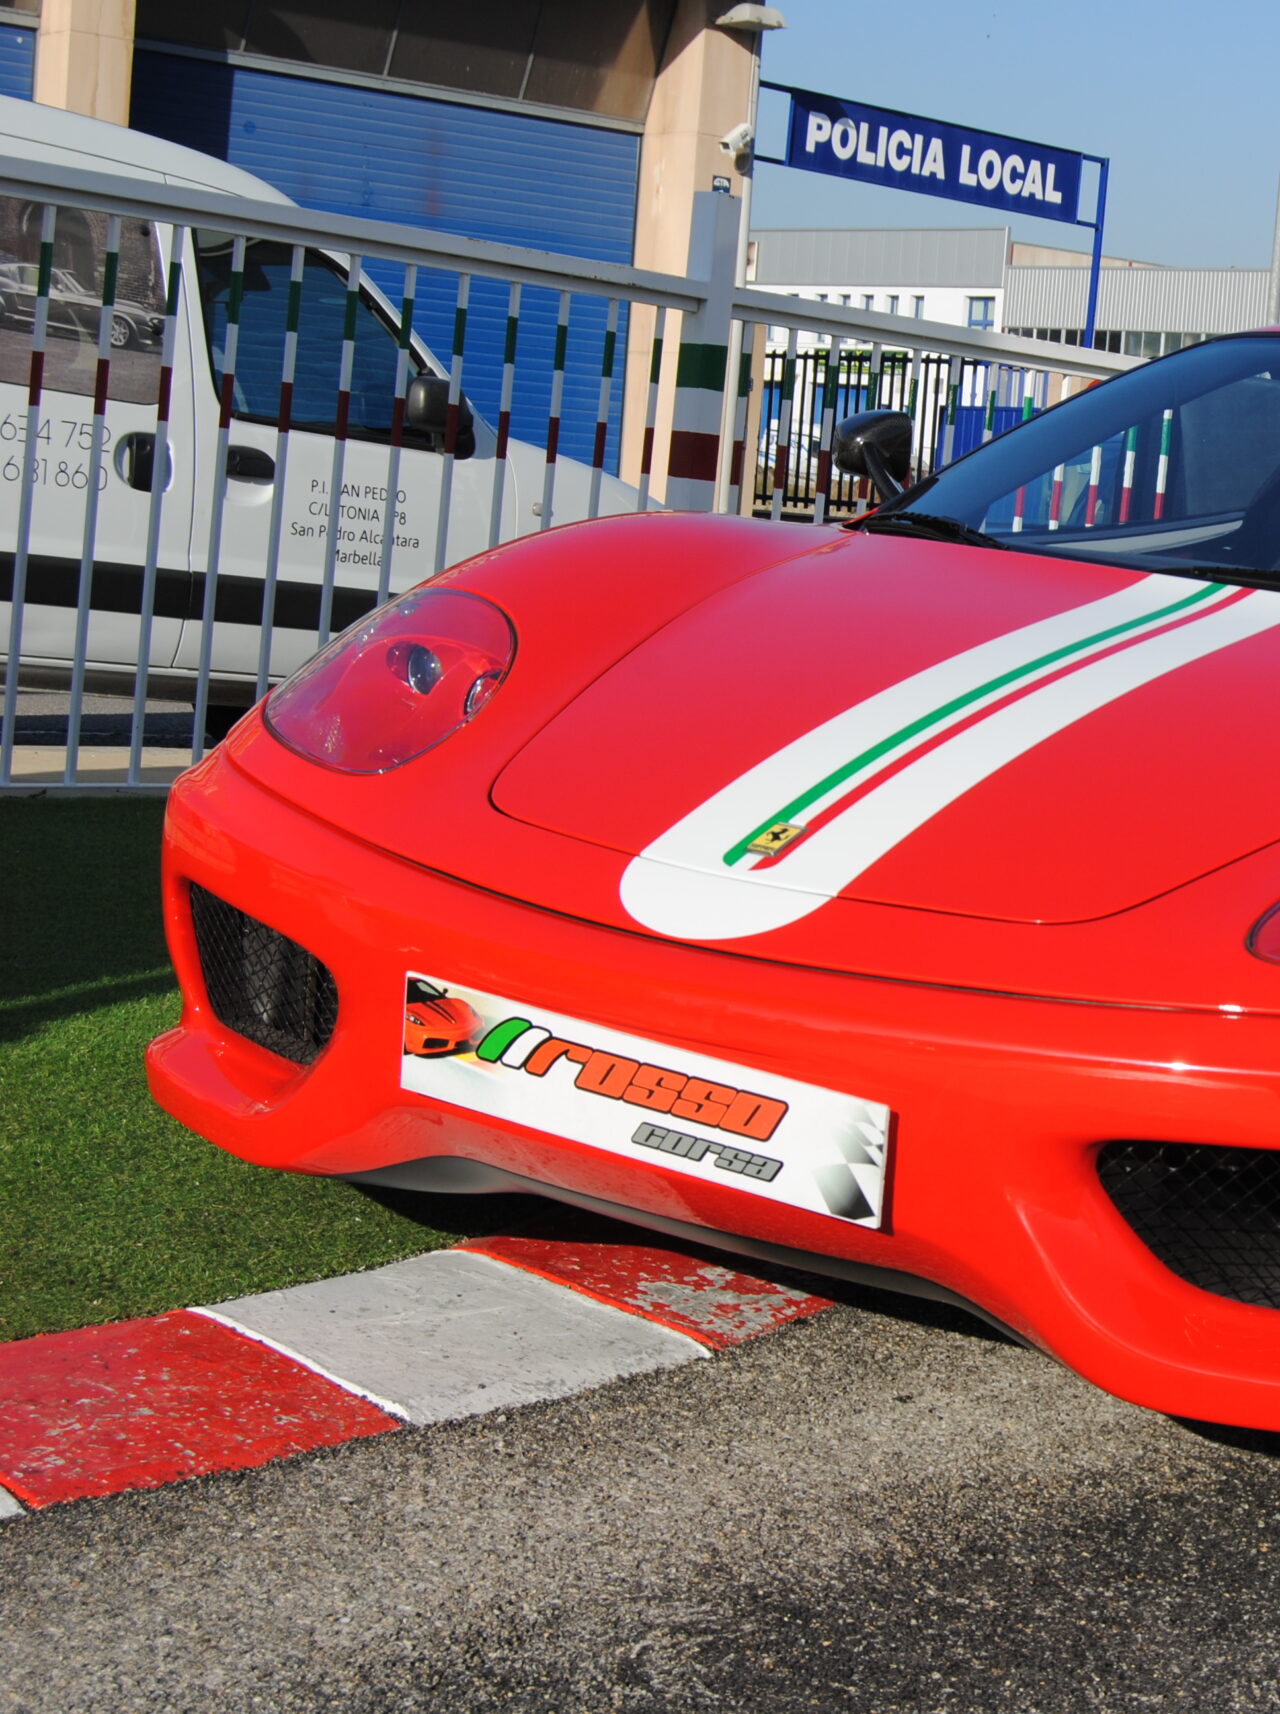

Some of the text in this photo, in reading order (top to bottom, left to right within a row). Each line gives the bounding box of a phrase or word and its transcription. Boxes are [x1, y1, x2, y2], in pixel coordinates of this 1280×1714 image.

[805, 111, 1062, 204] POLICIA LOCAL
[332, 482, 360, 498] AN
[364, 485, 407, 503] PEDO
[308, 501, 380, 522] C/LTONIA
[290, 521, 314, 537] San
[319, 524, 356, 542] Pdro
[630, 1121, 785, 1183] corsa
